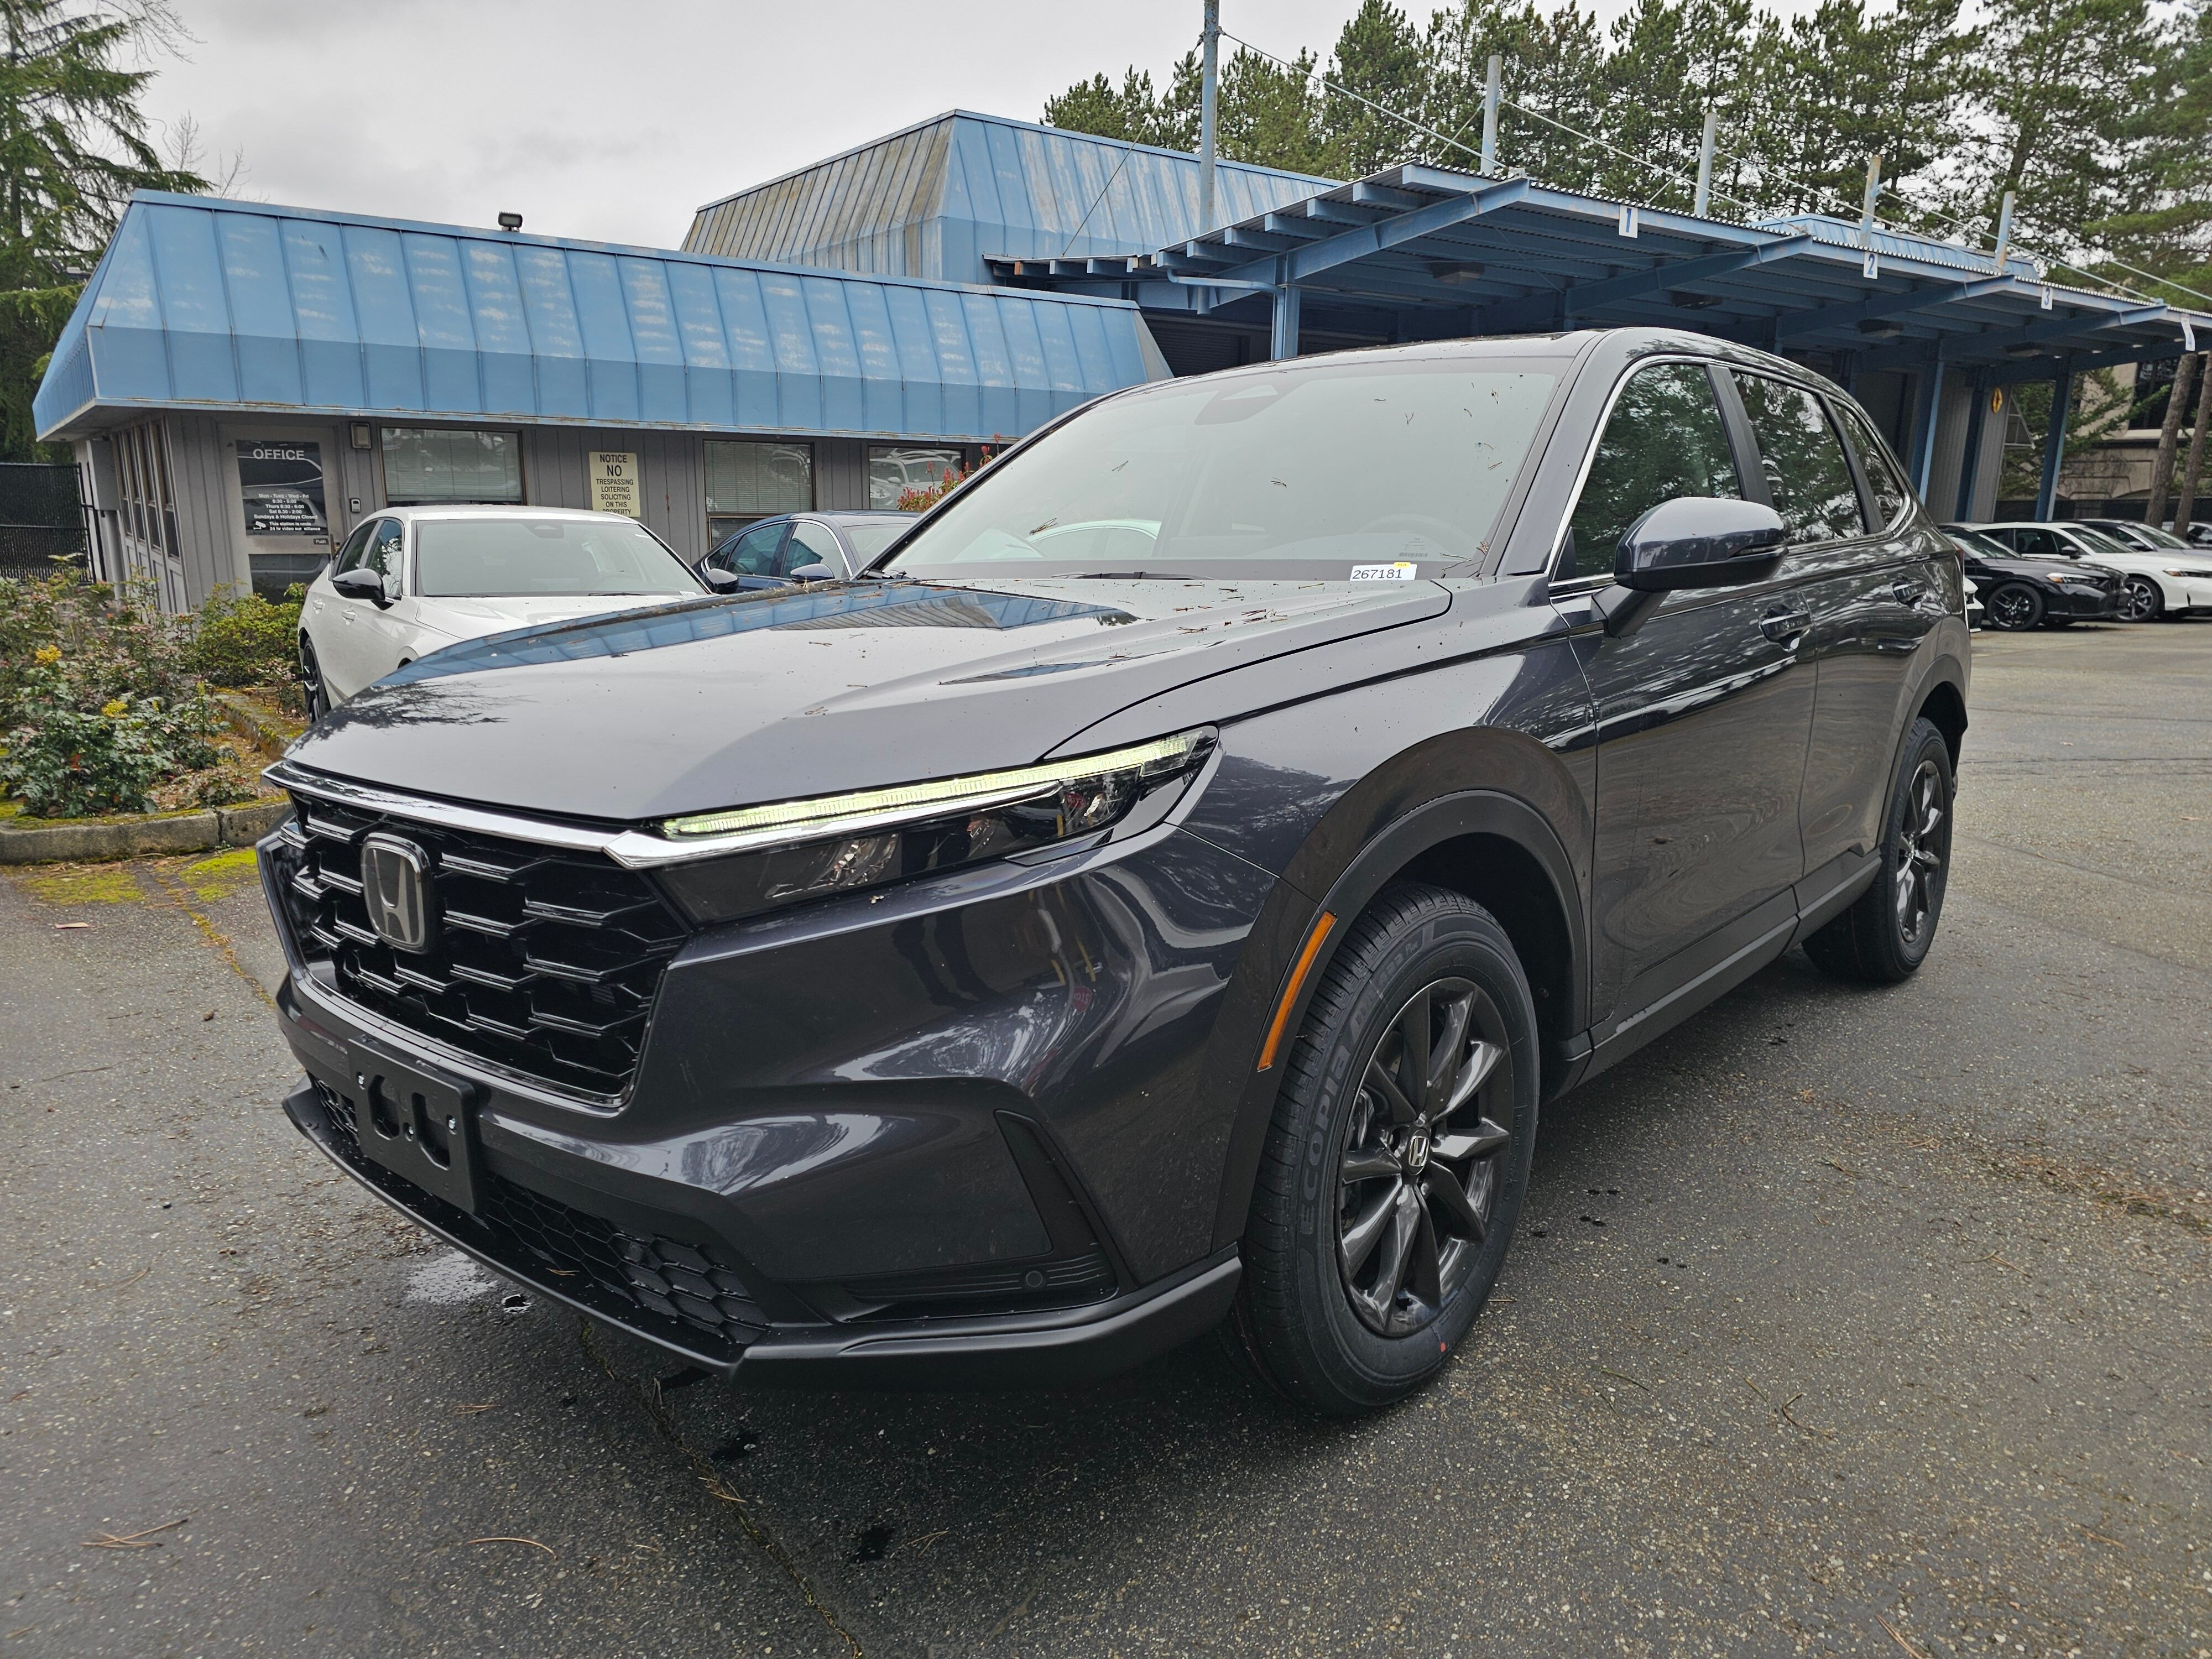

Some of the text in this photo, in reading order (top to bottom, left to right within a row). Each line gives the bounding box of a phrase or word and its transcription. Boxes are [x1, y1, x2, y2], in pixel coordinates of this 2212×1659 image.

[1626, 207, 1632, 233] 1
[1867, 253, 1875, 275] 2
[2044, 288, 2050, 306] 3
[253, 448, 305, 461] OFFICE
[599, 454, 628, 463] NOTICE
[607, 465, 622, 476] NO
[1352, 569, 1402, 580] 267181
